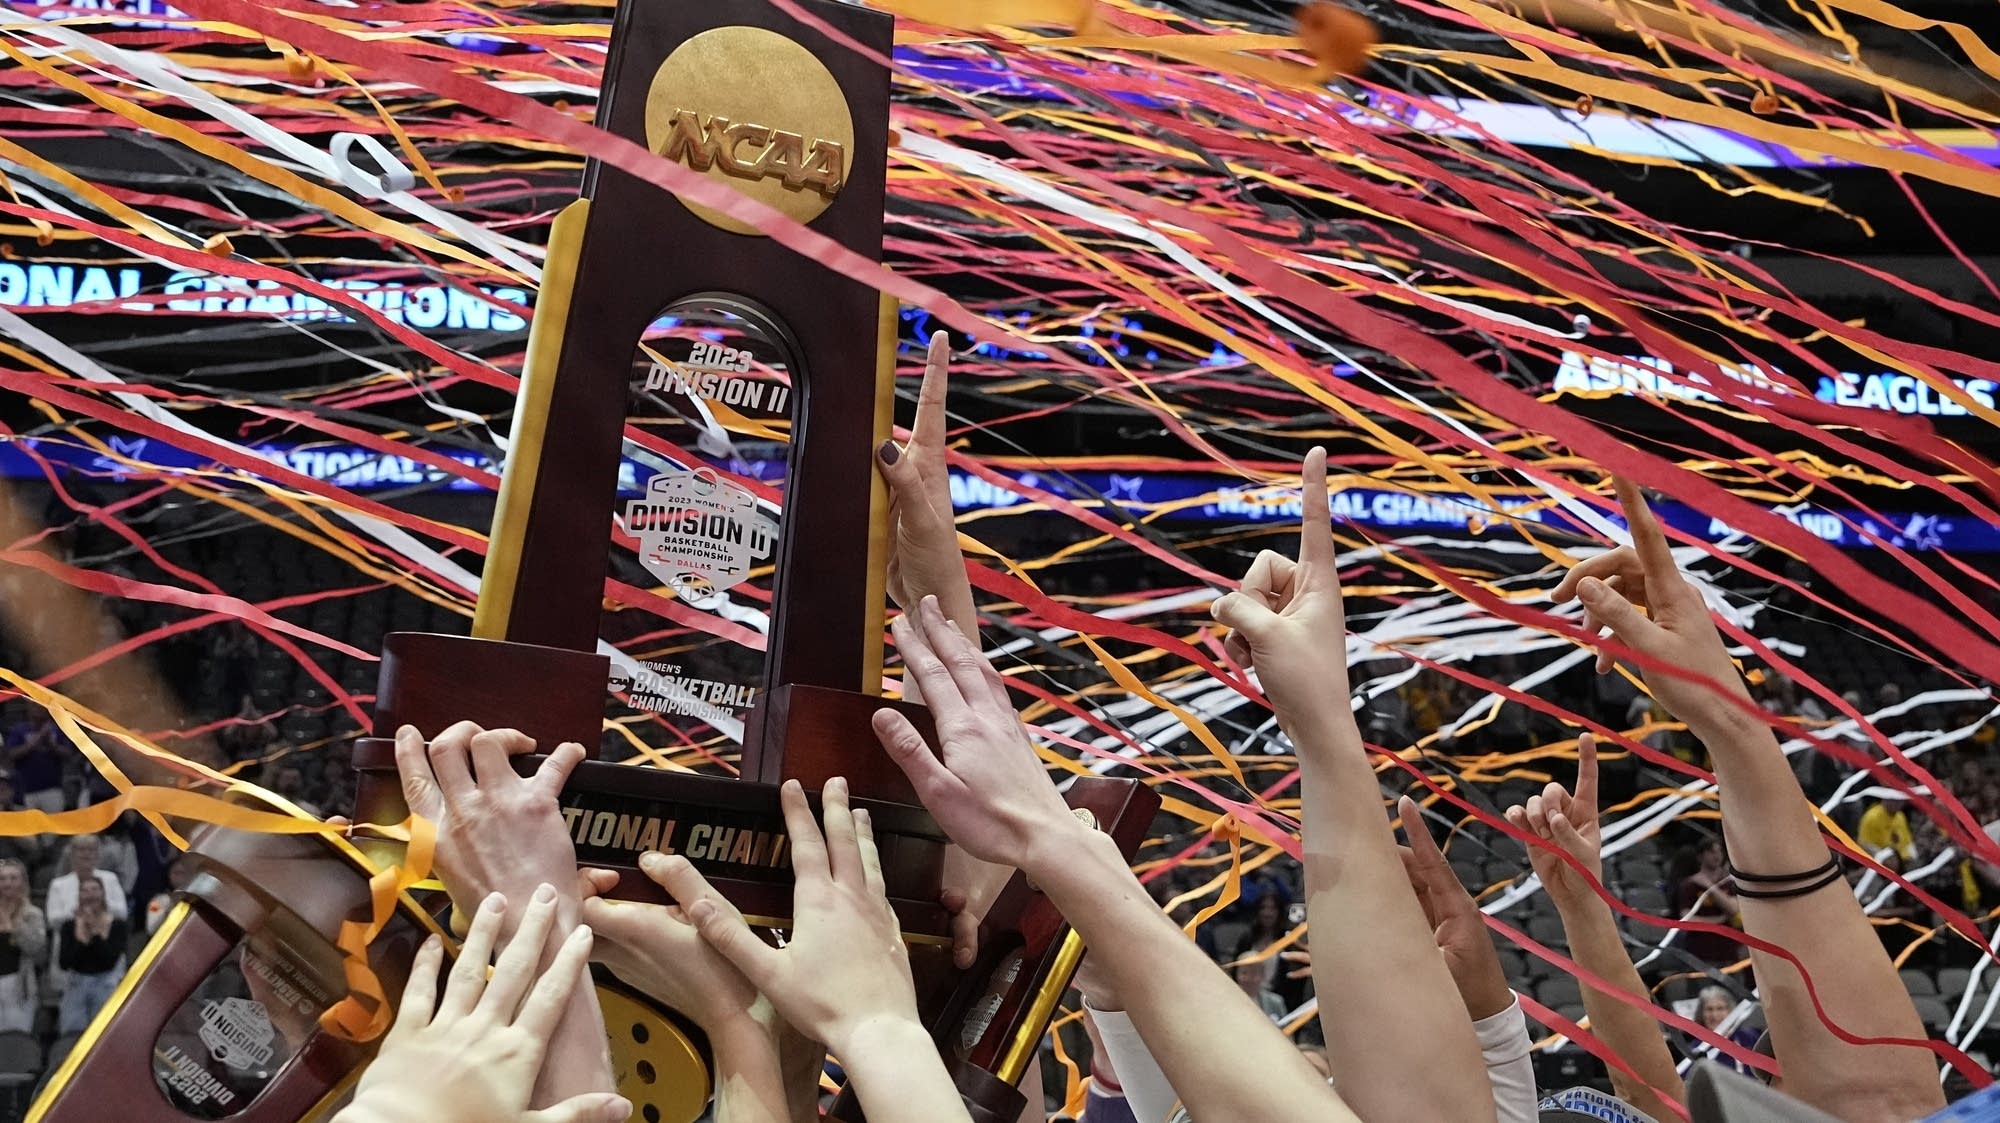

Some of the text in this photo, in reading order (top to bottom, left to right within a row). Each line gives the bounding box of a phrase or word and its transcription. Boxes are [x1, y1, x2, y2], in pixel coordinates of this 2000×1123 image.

[662, 108, 845, 198] NCAA
[688, 341, 753, 373] 2023
[645, 362, 789, 413] DIVISION II
[668, 496, 735, 513] 2023 WOMEN'S
[630, 504, 766, 552] DIVISION II
[657, 544, 734, 563] CHAMPIONSHIP
[664, 536, 729, 553] BASKETBALL
[677, 559, 712, 571] DALLAS
[639, 660, 682, 674] WOMEN'S
[632, 671, 756, 709] BASKETBALL
[627, 694, 734, 721] CHAMPIONSHIP
[204, 1005, 218, 1021] II
[213, 1012, 268, 1062] DIVISION
[164, 1044, 236, 1107] DIVISION II
[168, 1072, 210, 1105] 2023
[1565, 1090, 1628, 1116] NATIONAL
